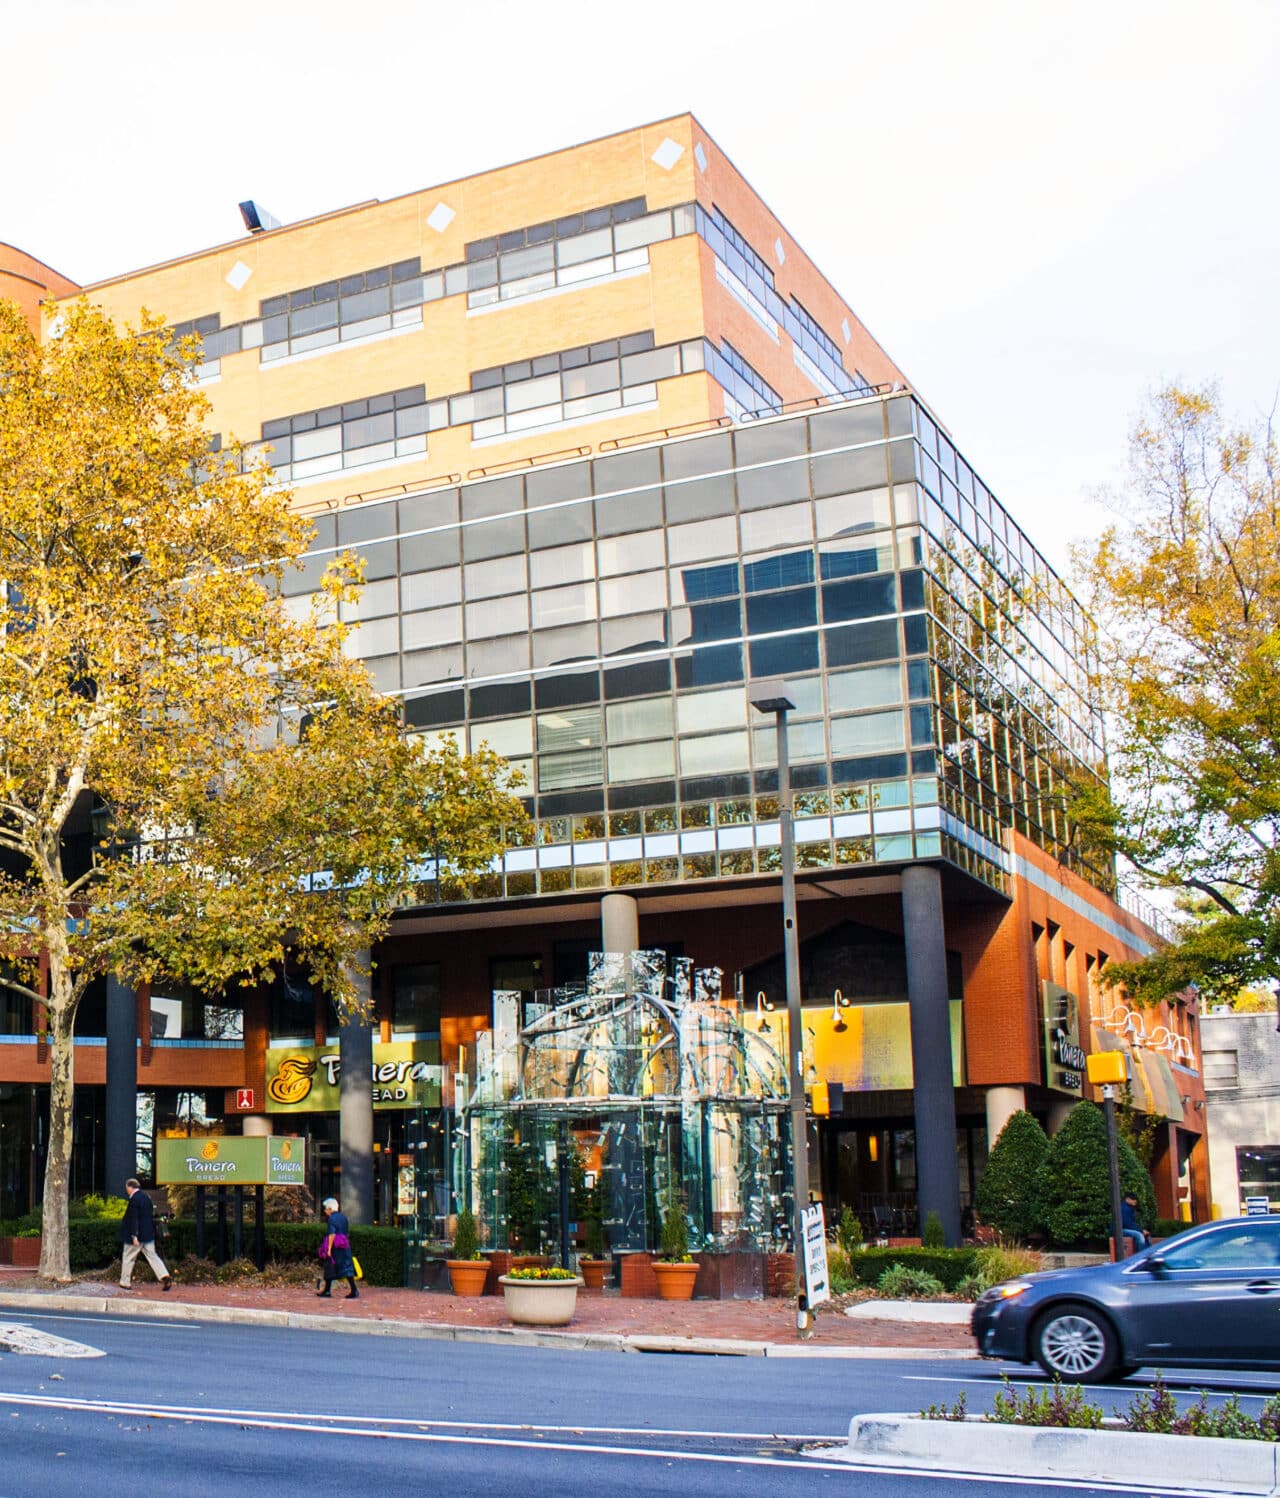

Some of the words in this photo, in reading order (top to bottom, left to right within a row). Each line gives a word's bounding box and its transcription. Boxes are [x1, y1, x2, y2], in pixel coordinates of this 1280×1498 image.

[1054, 1028, 1086, 1072] Panera
[320, 1055, 426, 1085] Pera
[372, 1088, 406, 1100] EAD
[186, 1157, 237, 1173] Panera
[272, 1157, 302, 1172] Panera
